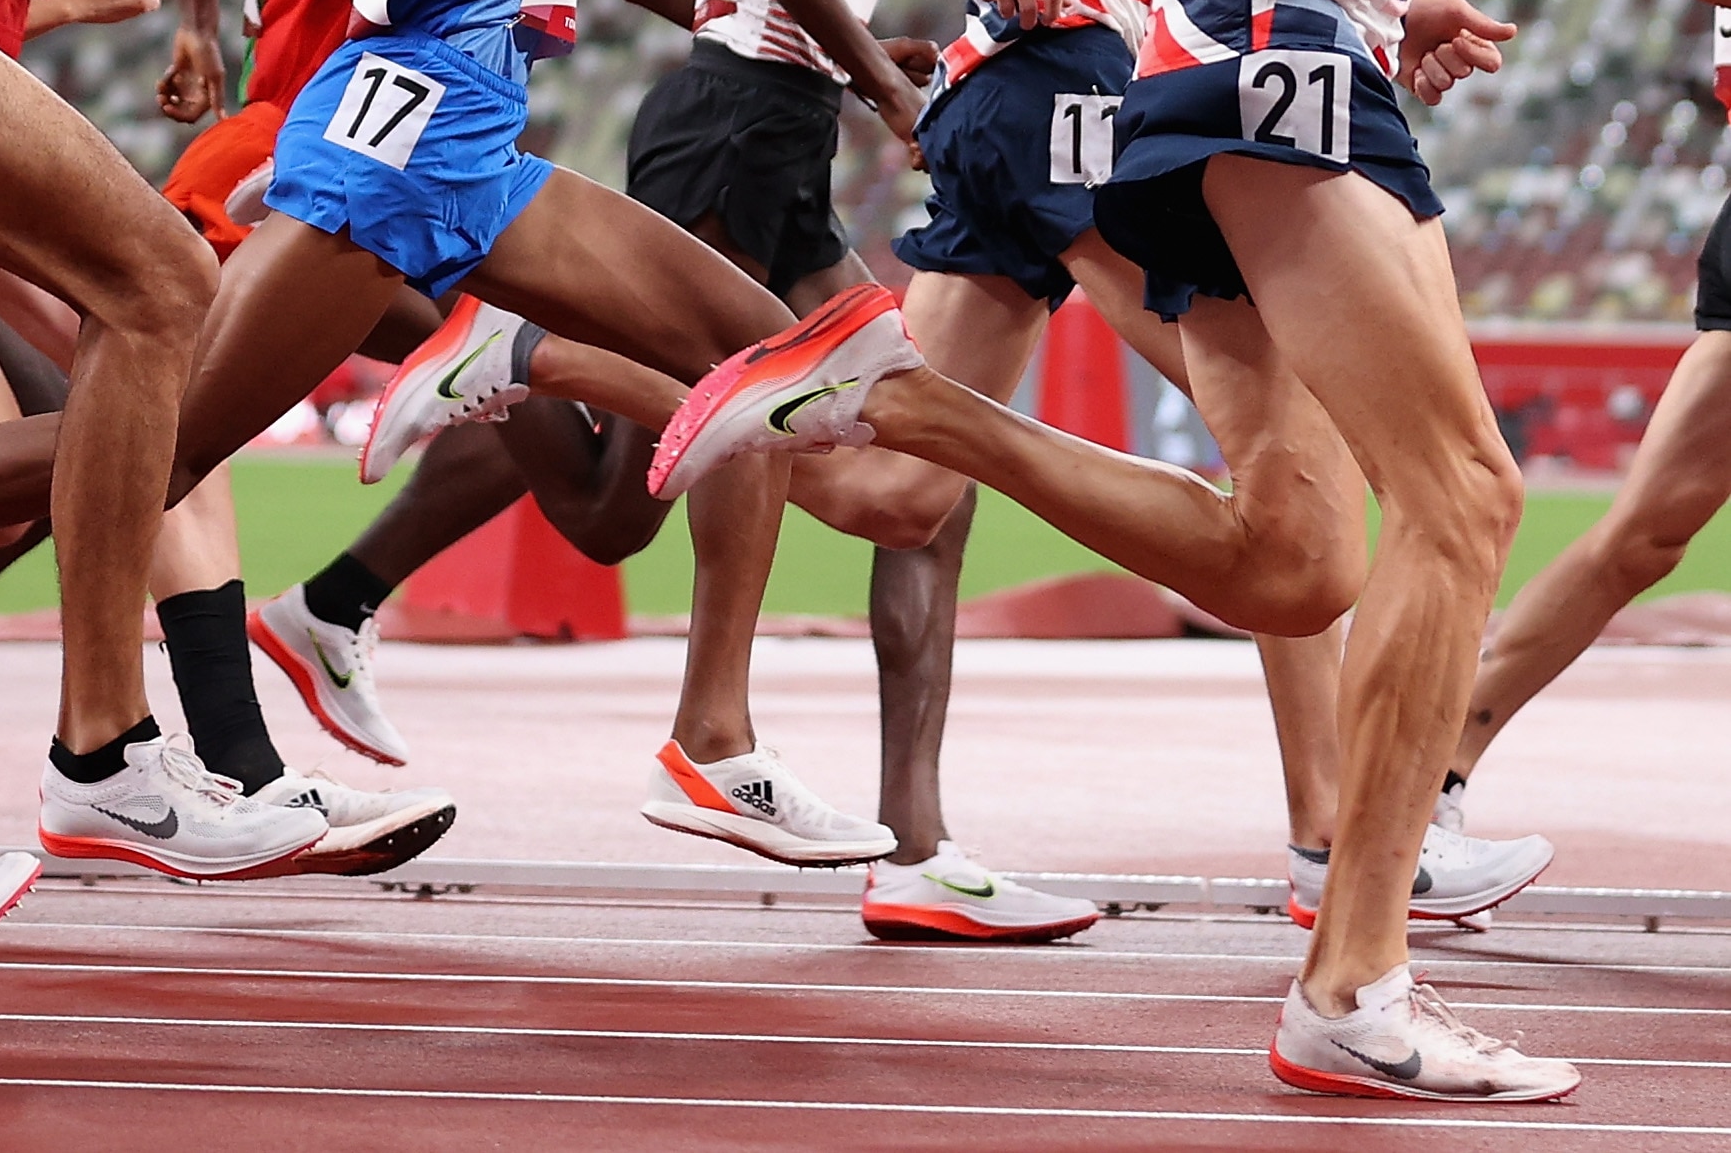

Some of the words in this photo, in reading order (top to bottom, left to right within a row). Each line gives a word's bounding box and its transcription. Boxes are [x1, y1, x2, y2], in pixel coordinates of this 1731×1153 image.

[347, 68, 431, 148] 17
[1252, 62, 1336, 155] 21
[731, 787, 778, 817] adidas
